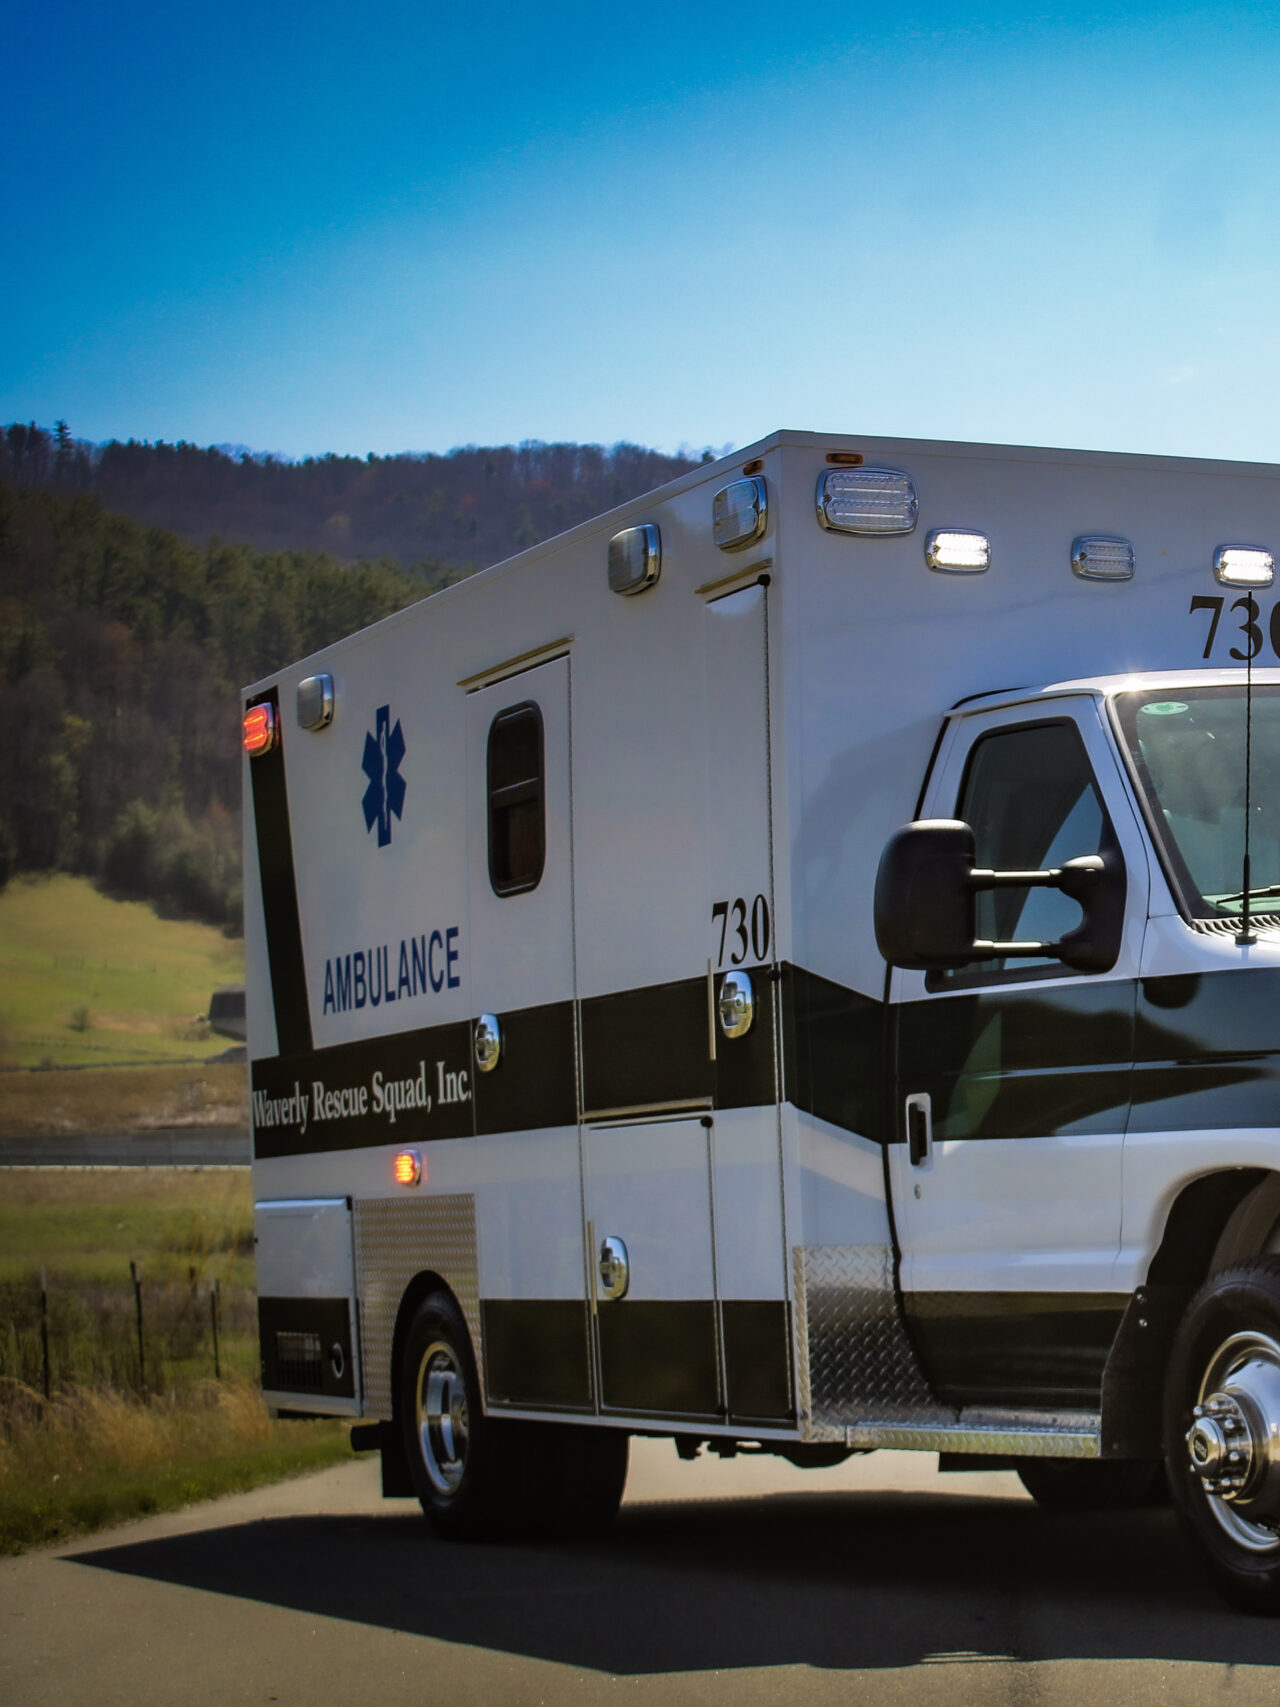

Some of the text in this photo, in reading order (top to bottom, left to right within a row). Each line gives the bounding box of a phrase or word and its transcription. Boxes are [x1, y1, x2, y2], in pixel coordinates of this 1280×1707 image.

[711, 893, 770, 967] 730
[322, 926, 461, 1016] AMBULANCE
[252, 1060, 472, 1134] Waverly Rescue Squad, Inc.
